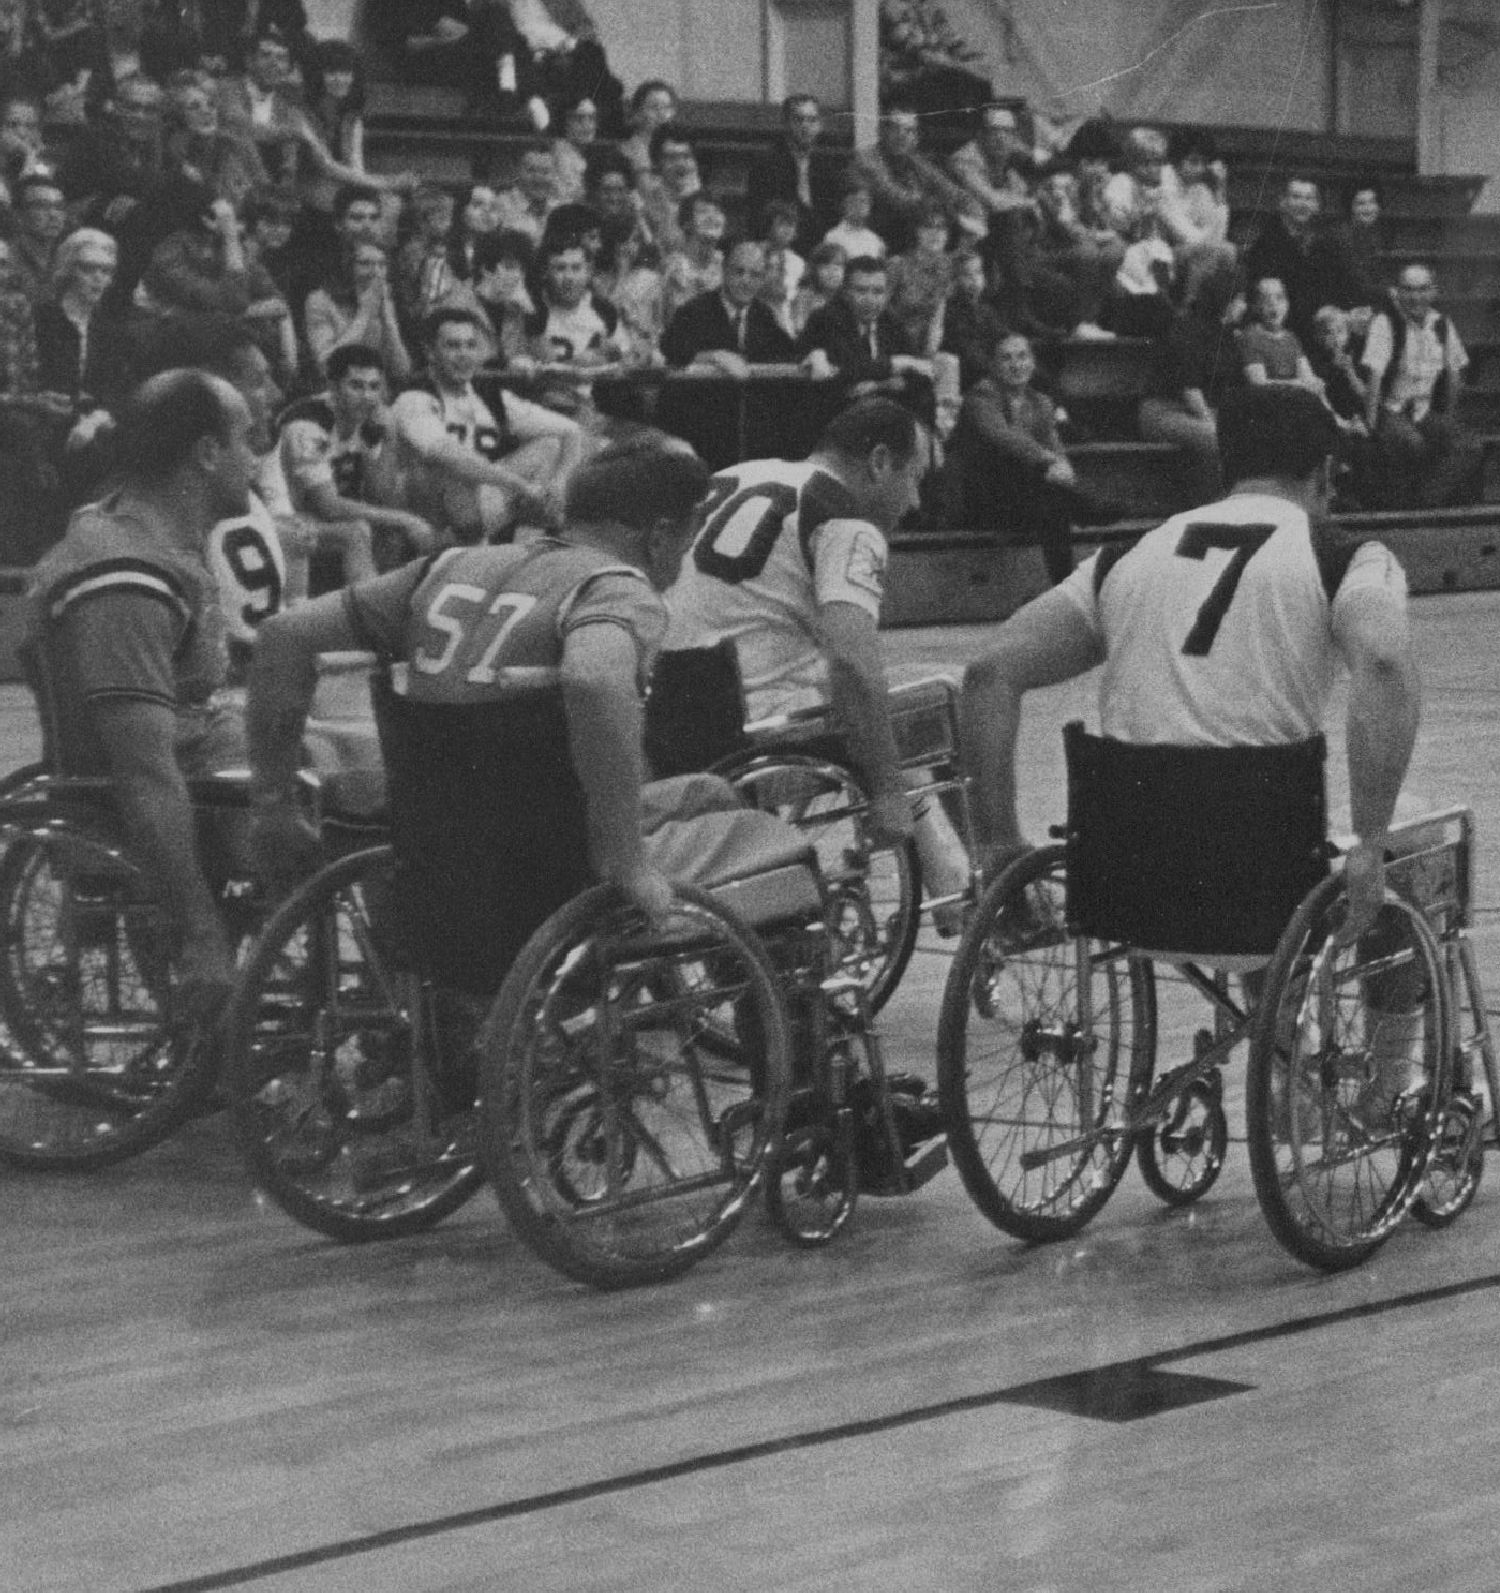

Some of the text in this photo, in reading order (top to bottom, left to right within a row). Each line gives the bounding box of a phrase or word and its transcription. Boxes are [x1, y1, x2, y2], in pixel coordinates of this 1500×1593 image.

[221, 525, 282, 629] 9
[1174, 522, 1278, 657] 7
[415, 582, 537, 683] 57
